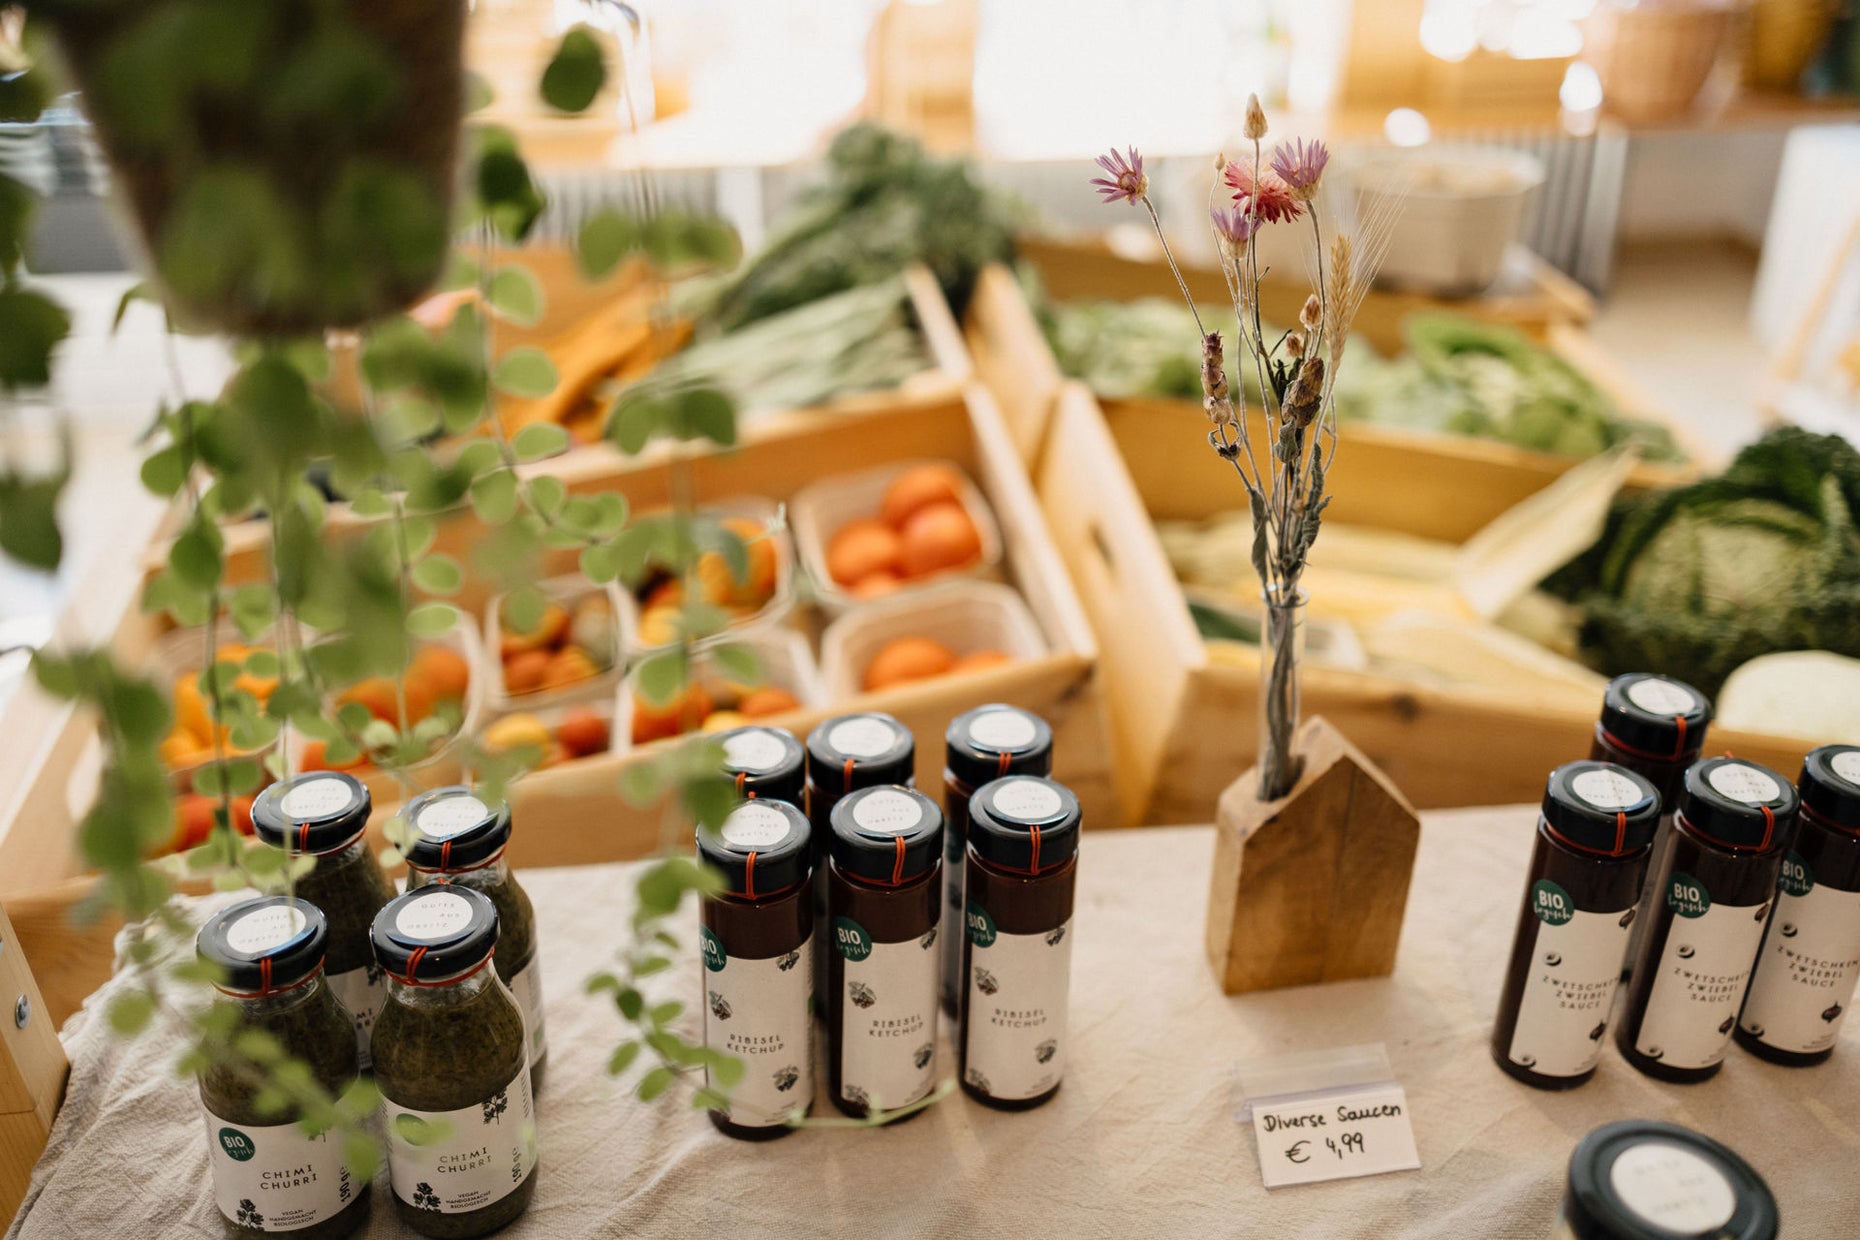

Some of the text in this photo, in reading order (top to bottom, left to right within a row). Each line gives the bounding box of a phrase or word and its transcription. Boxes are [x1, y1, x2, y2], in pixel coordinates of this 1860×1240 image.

[1782, 860, 1804, 880] BIO
[1538, 889, 1564, 910] BIO
[1674, 882, 1700, 903] BIO
[967, 912, 987, 931] BIO
[837, 927, 861, 945] BIO
[1788, 962, 1843, 979] ZWIEBEL
[1791, 973, 1834, 988] SAUCE
[1559, 1001, 1600, 1010] SAUCE
[1690, 993, 1732, 1003] SAUCE
[869, 1021, 924, 1038] KETCHUP
[872, 1014, 921, 1029] RIBISEL
[991, 1017, 1047, 1029] KETCHUP
[730, 1033, 780, 1045] RIBISEL
[727, 1042, 784, 1054] KETCHUP
[1263, 1104, 1401, 1132] Diverse Saucen
[223, 1135, 246, 1149] BIO
[1284, 1132, 1365, 1164] € 4,99
[439, 1146, 487, 1164] CHIMI
[262, 1164, 312, 1180] CHIMI
[437, 1155, 492, 1173] CHURRI
[260, 1173, 318, 1190] CHURRI
[457, 1190, 479, 1198] VEGAN
[281, 1209, 304, 1217] VEGAN
